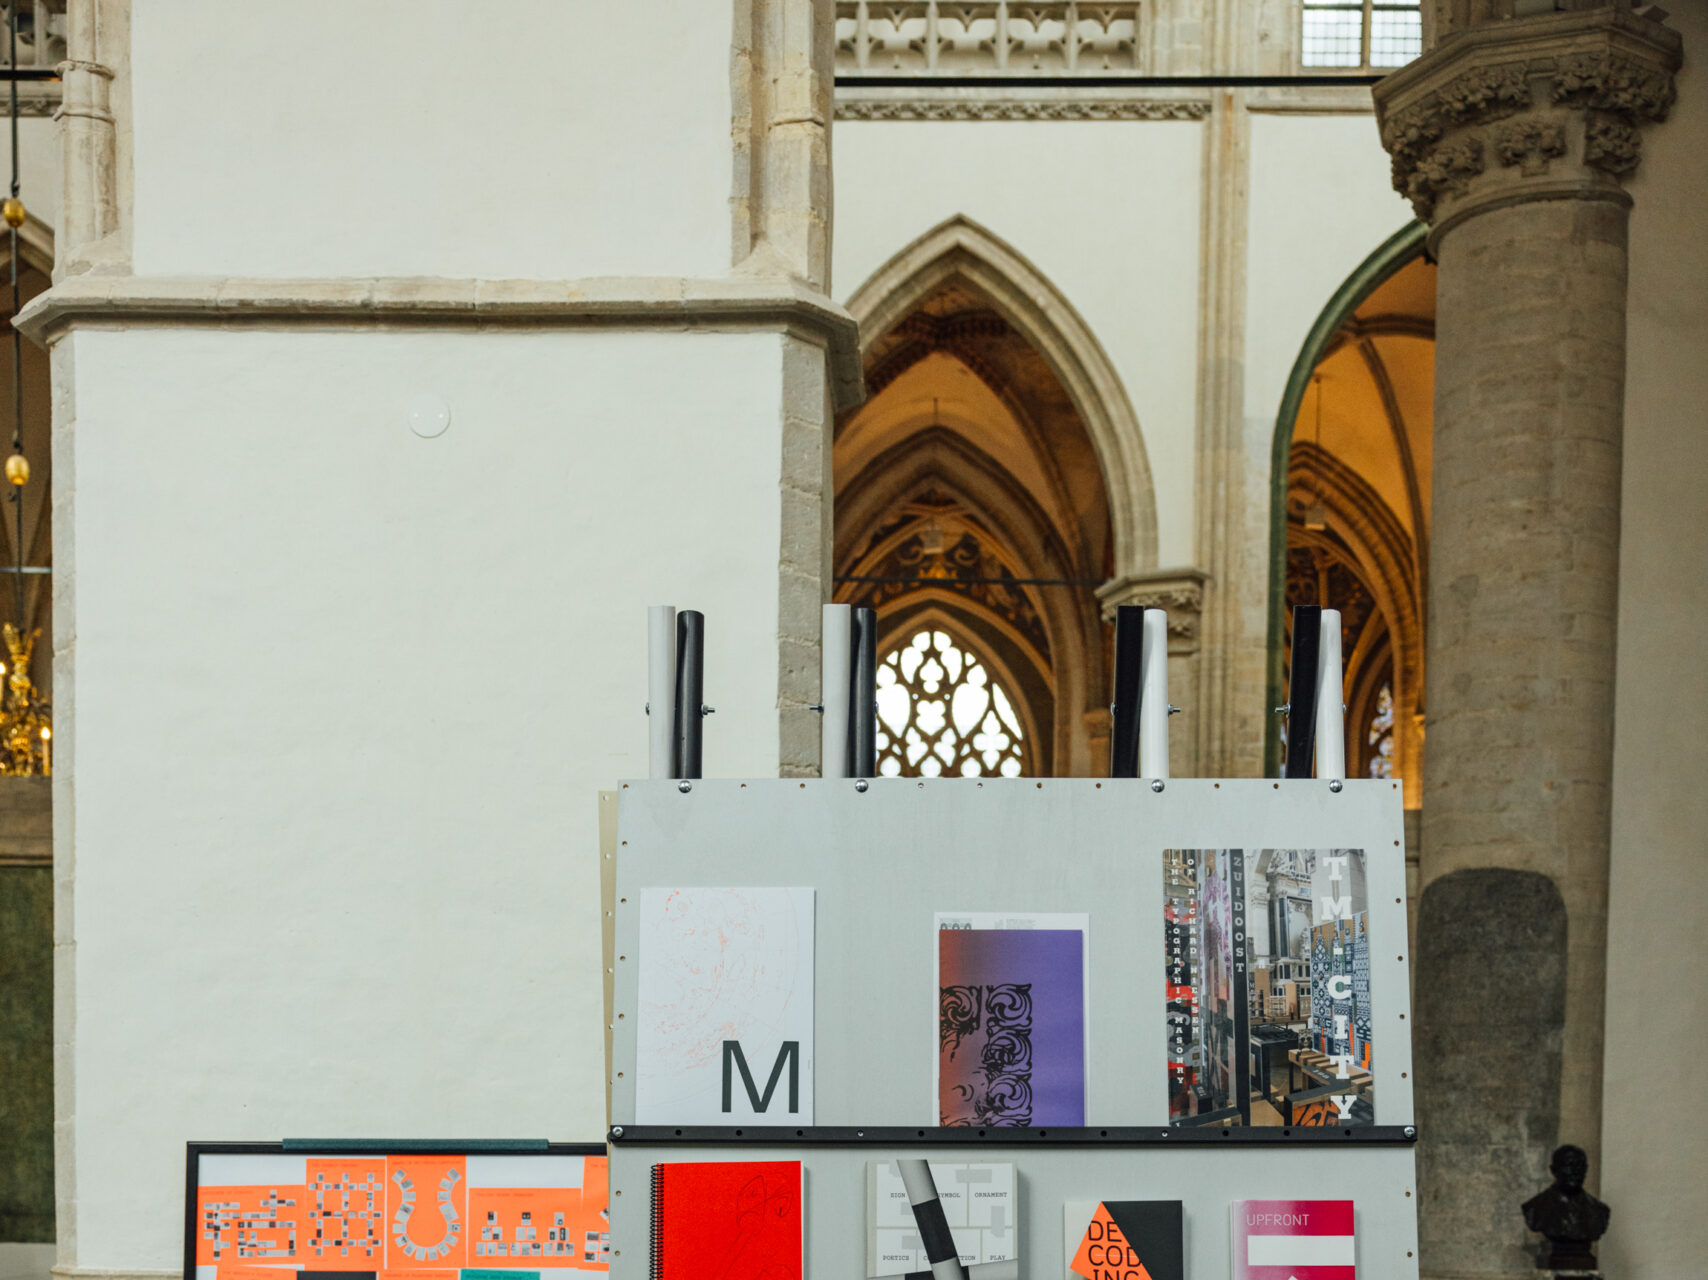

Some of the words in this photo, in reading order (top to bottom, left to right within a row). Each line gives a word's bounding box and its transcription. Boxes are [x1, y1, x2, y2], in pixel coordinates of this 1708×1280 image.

[1171, 859, 1179, 885] THE
[1233, 857, 1245, 973] ZUIDOOST
[1172, 898, 1183, 1004] TYPOGRAPHIC
[721, 1040, 799, 1113] M
[1175, 1017, 1185, 1084] MASONRY
[1088, 1220, 1122, 1242] DE
[1246, 1213, 1310, 1226] UPFRONT
